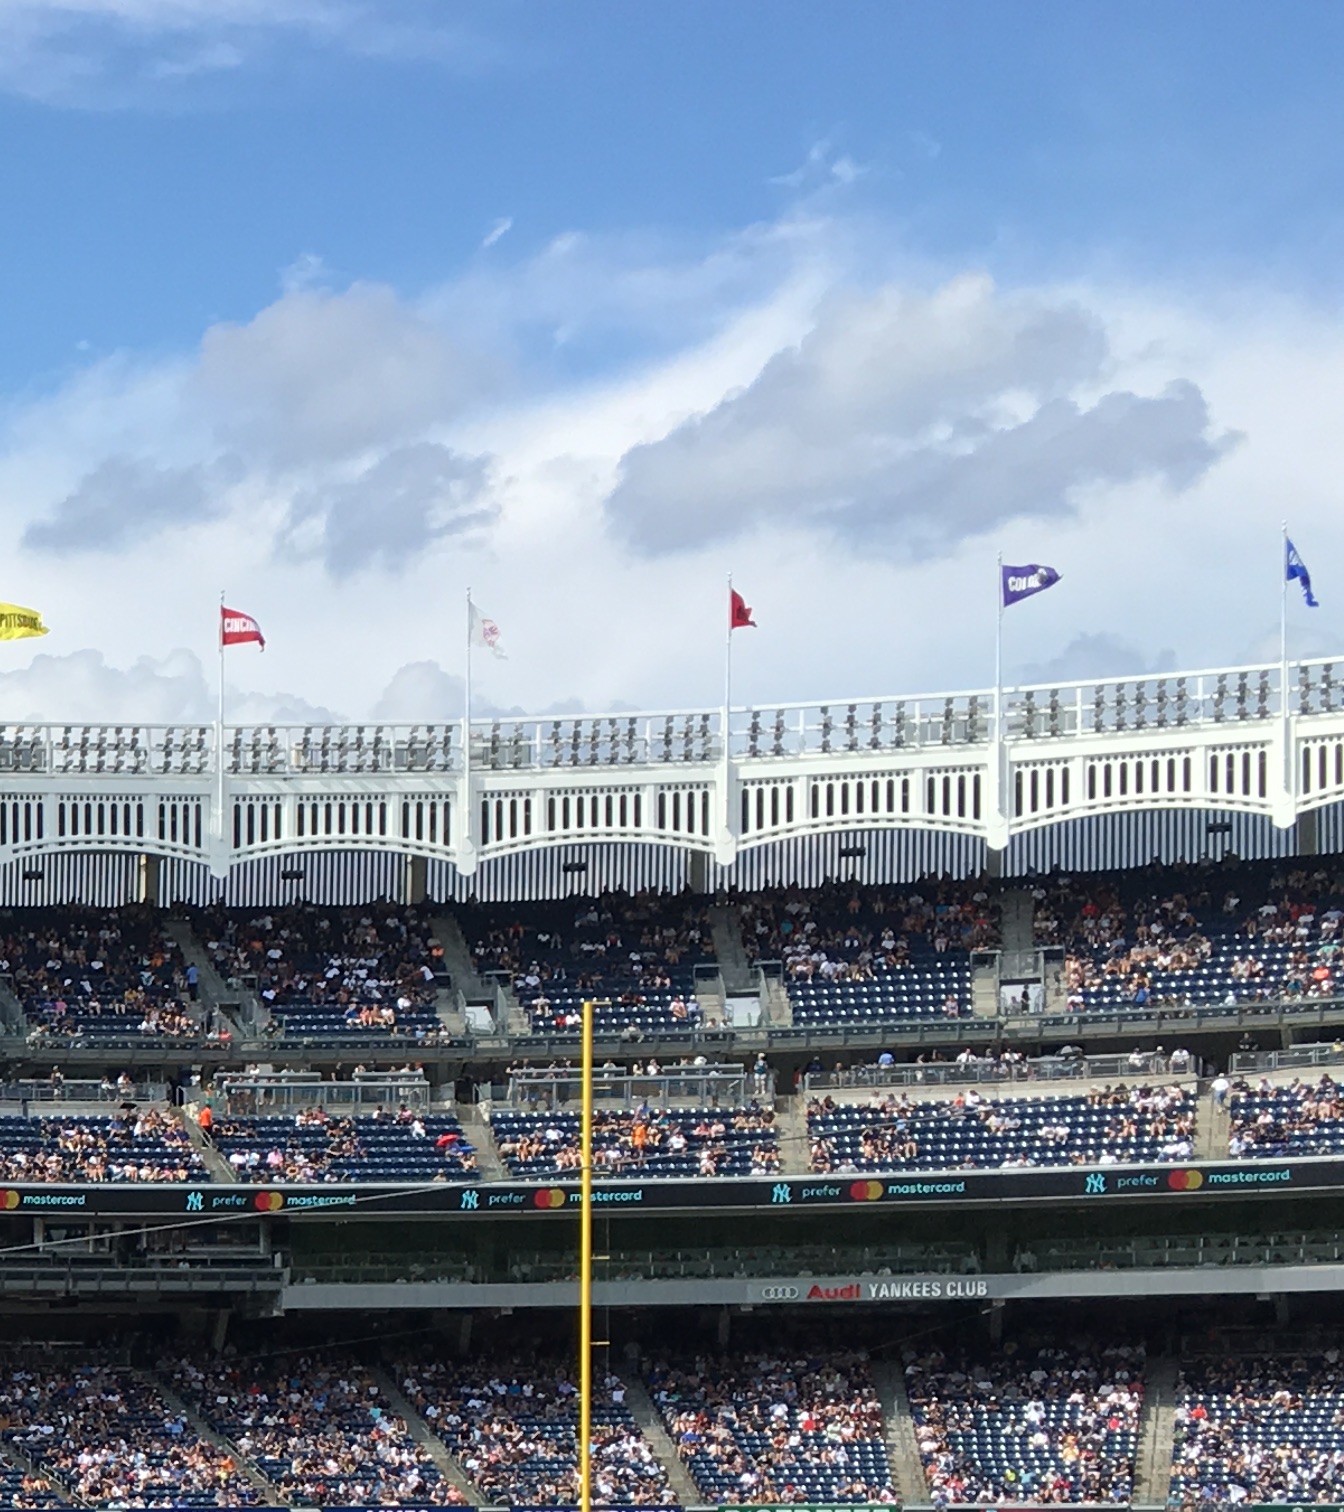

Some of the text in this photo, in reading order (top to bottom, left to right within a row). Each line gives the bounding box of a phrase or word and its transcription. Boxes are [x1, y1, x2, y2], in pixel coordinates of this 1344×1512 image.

[1117, 1175, 1159, 1188] prefer
[1207, 1170, 1291, 1183] mastercard
[488, 1194, 526, 1206] prefer
[569, 1190, 643, 1202] mstercard
[801, 1186, 842, 1199] prefer
[887, 1182, 965, 1195] mastercard
[22, 1194, 86, 1205] mastercard
[212, 1194, 247, 1207] prefer
[286, 1195, 357, 1206] mastercard
[806, 1281, 988, 1299] Audi YANKEES CLUB
